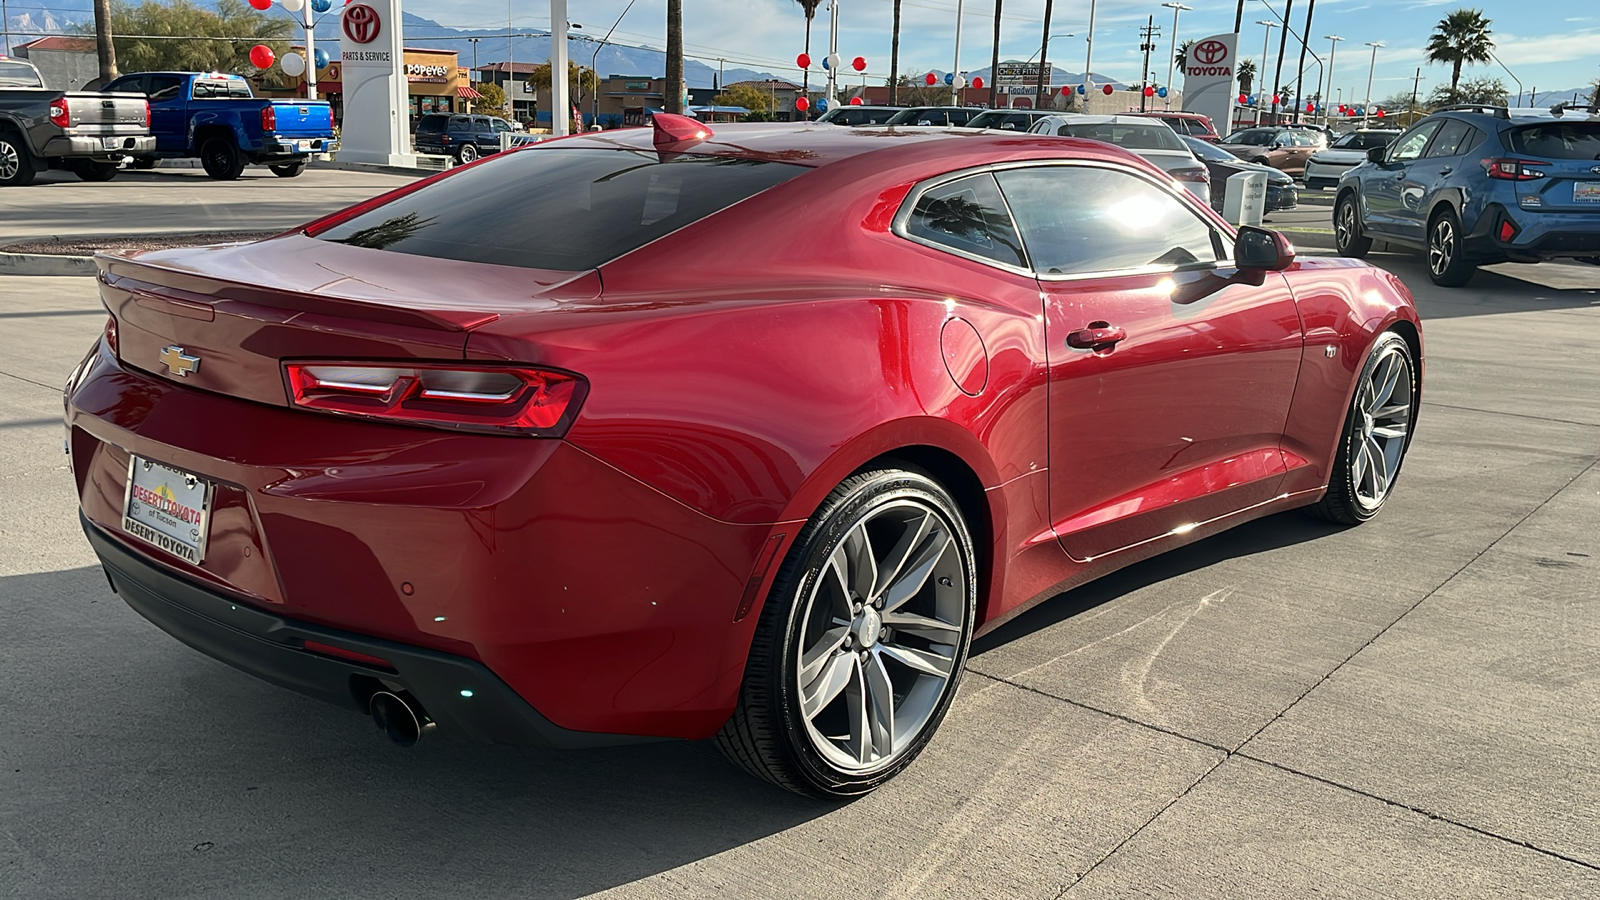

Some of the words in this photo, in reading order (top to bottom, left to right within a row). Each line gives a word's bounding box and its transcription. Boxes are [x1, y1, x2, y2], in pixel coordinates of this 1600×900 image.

[343, 51, 359, 61] PARTS
[359, 51, 365, 61] &
[365, 51, 390, 61] SERVICE
[1187, 66, 1231, 76] TOYOTA
[132, 484, 164, 509] DESERT
[166, 499, 201, 526] TOYOTA
[148, 509, 156, 517] of
[156, 512, 177, 528] Tucson
[124, 518, 155, 542] DESERT
[157, 534, 194, 561] TOYOTA
